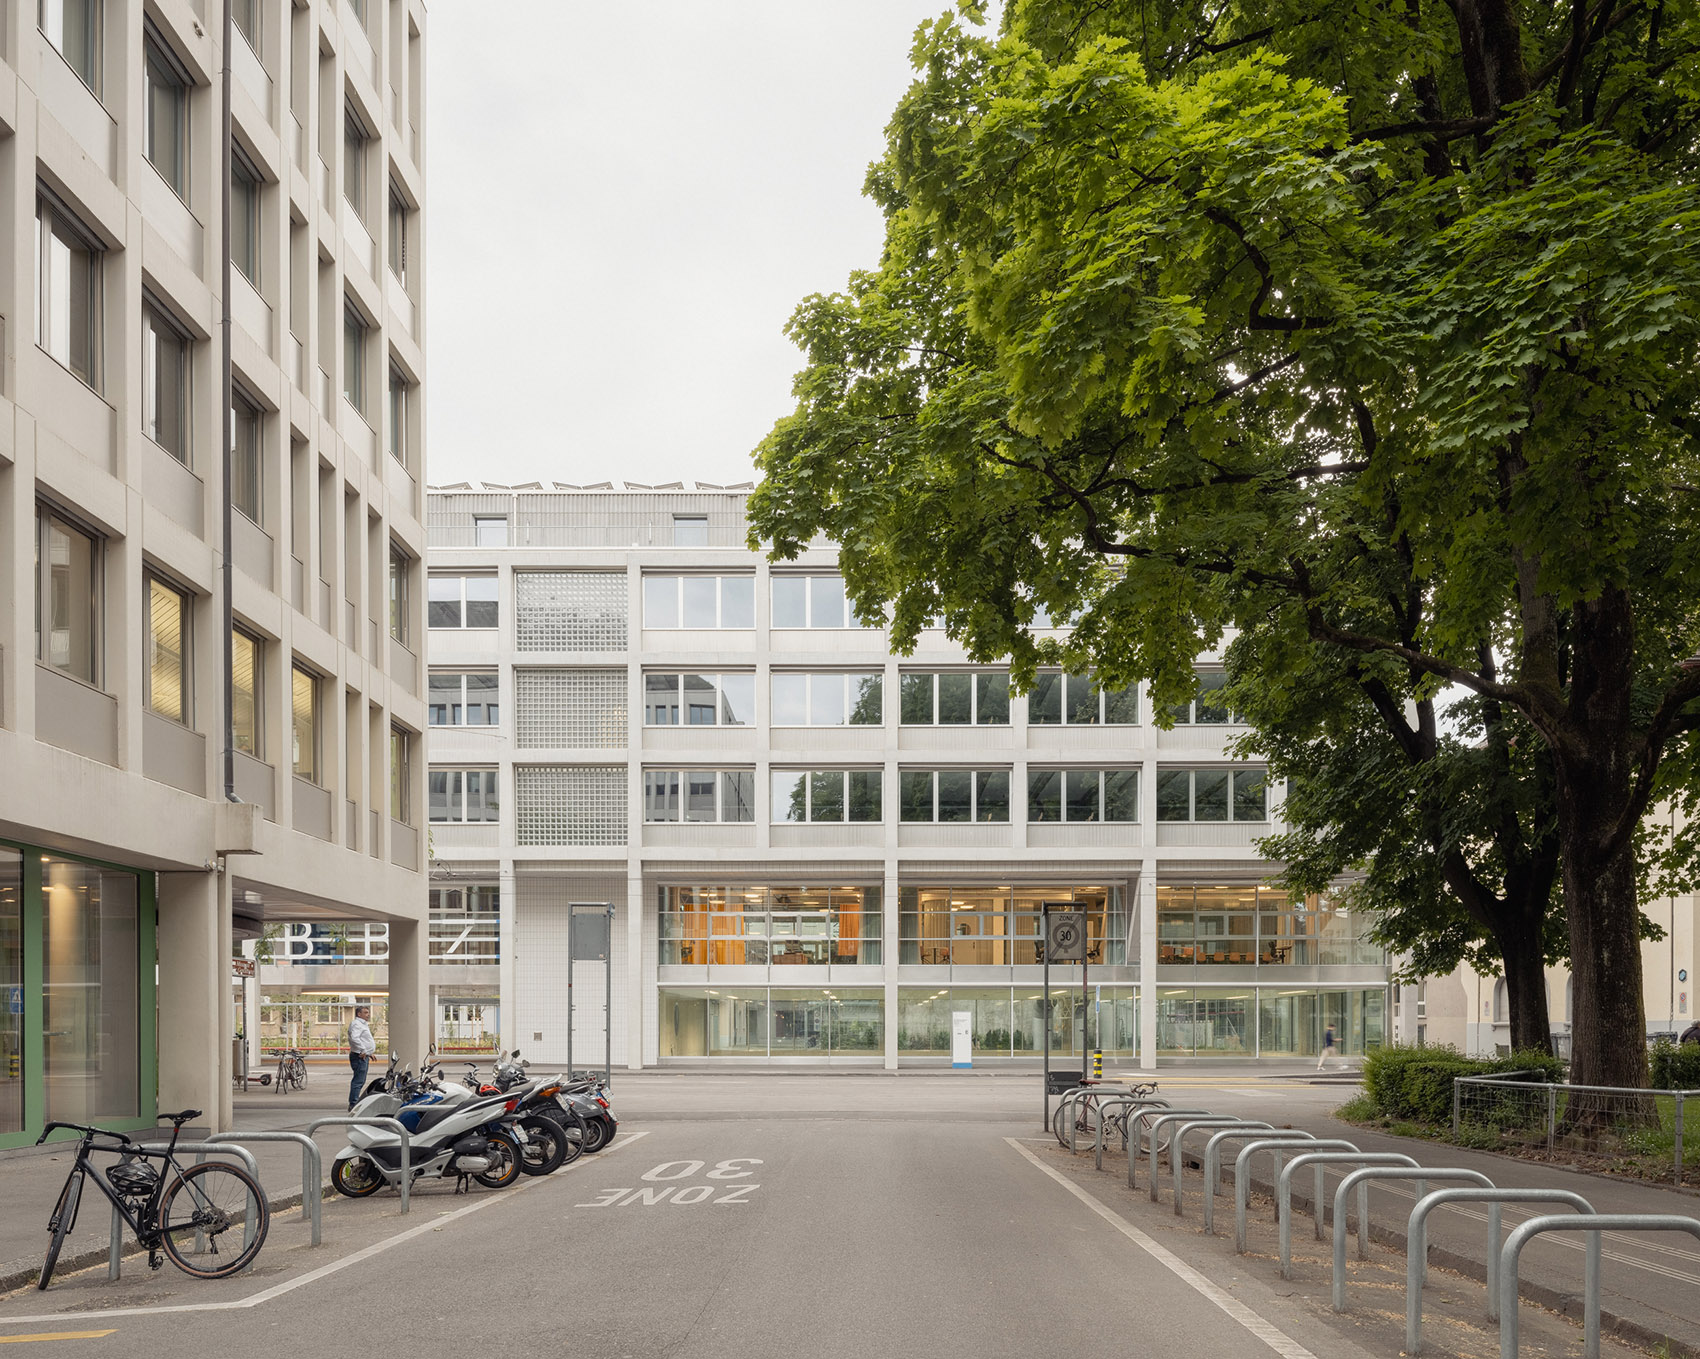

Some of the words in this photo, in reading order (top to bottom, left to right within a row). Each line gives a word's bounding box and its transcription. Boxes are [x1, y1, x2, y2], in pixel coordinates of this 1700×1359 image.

[1060, 930, 1072, 942] 30
[640, 1158, 764, 1182] 30
[573, 1184, 761, 1208] ZONE
